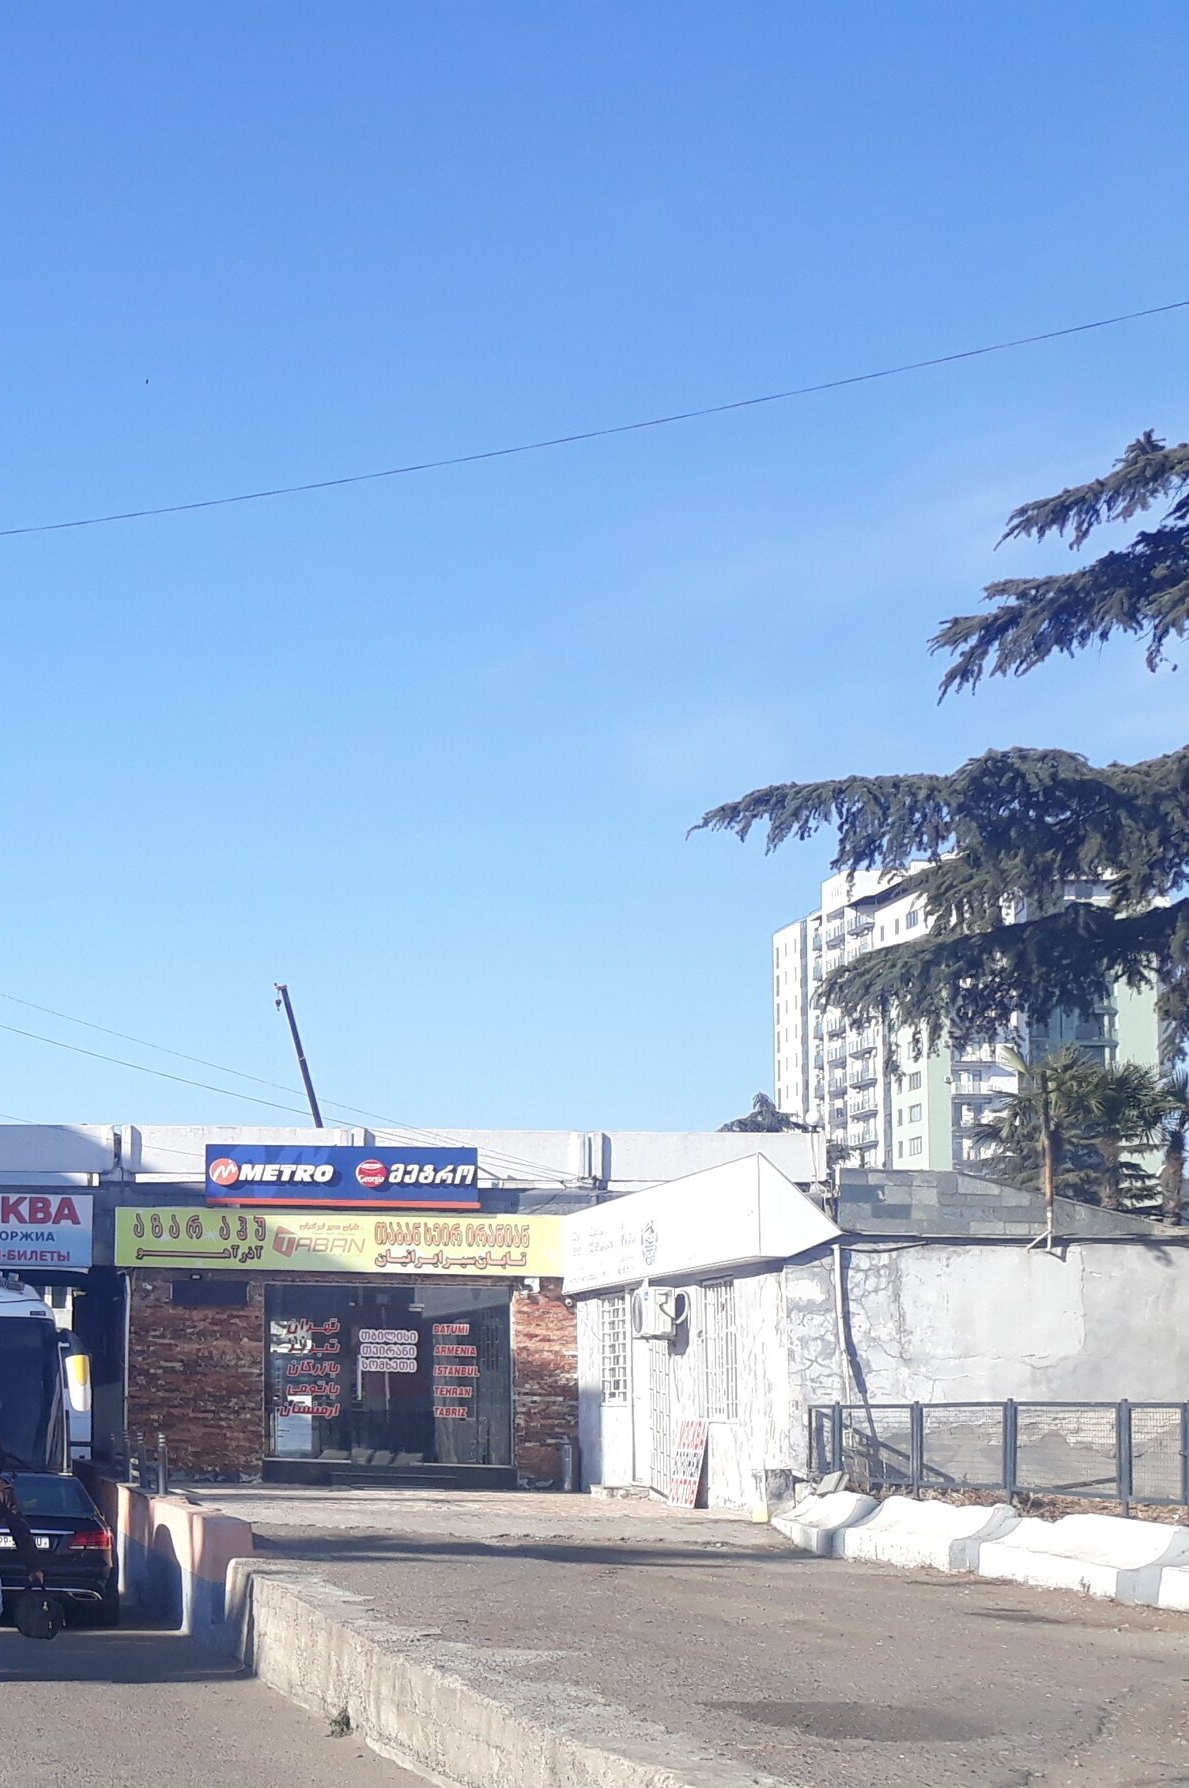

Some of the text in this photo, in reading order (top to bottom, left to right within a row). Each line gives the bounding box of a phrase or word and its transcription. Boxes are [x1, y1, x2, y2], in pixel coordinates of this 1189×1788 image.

[238, 1164, 334, 1183] METRO
[388, 1163, 476, 1185] მეტრო
[133, 1213, 203, 1239] აზარ
[432, 1324, 470, 1335] BATUMI
[360, 1330, 417, 1343] თბილისი
[362, 1344, 416, 1357] თეირანი
[434, 1346, 478, 1357] ARMENIA
[361, 1359, 416, 1371] სომხეთი
[433, 1365, 481, 1377] ISTANBUL
[433, 1386, 473, 1397] TEHRAN
[433, 1407, 468, 1418] TABRIZ
